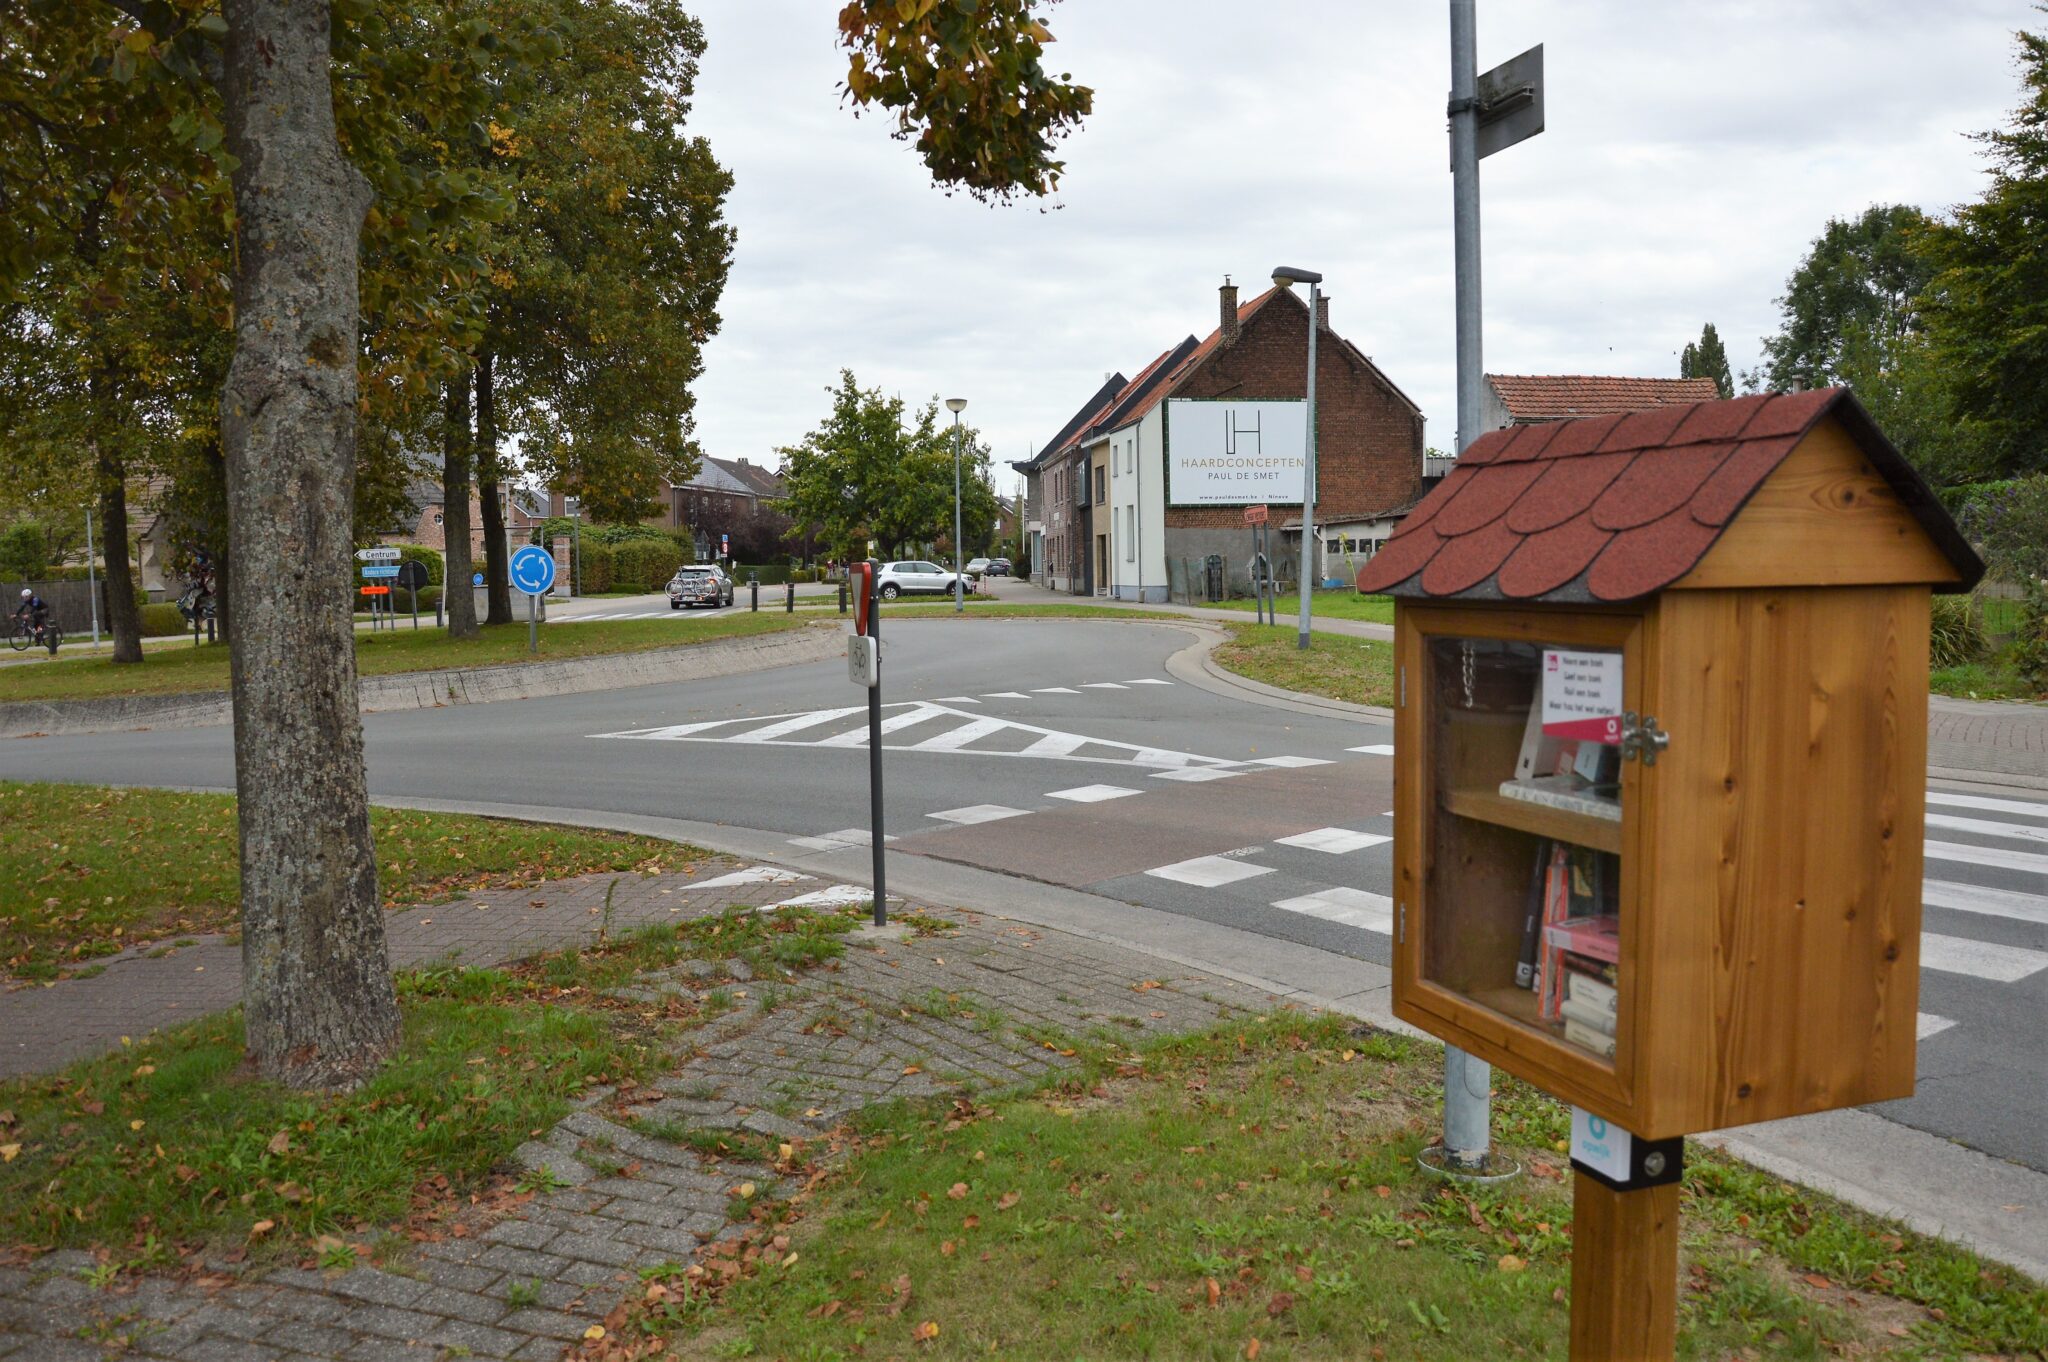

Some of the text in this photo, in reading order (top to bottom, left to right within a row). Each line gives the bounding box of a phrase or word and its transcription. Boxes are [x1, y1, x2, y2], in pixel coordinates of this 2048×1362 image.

[1181, 458, 1304, 468] HAARDCONCEPTEN
[1208, 472, 1280, 480] PAUL DE SMET
